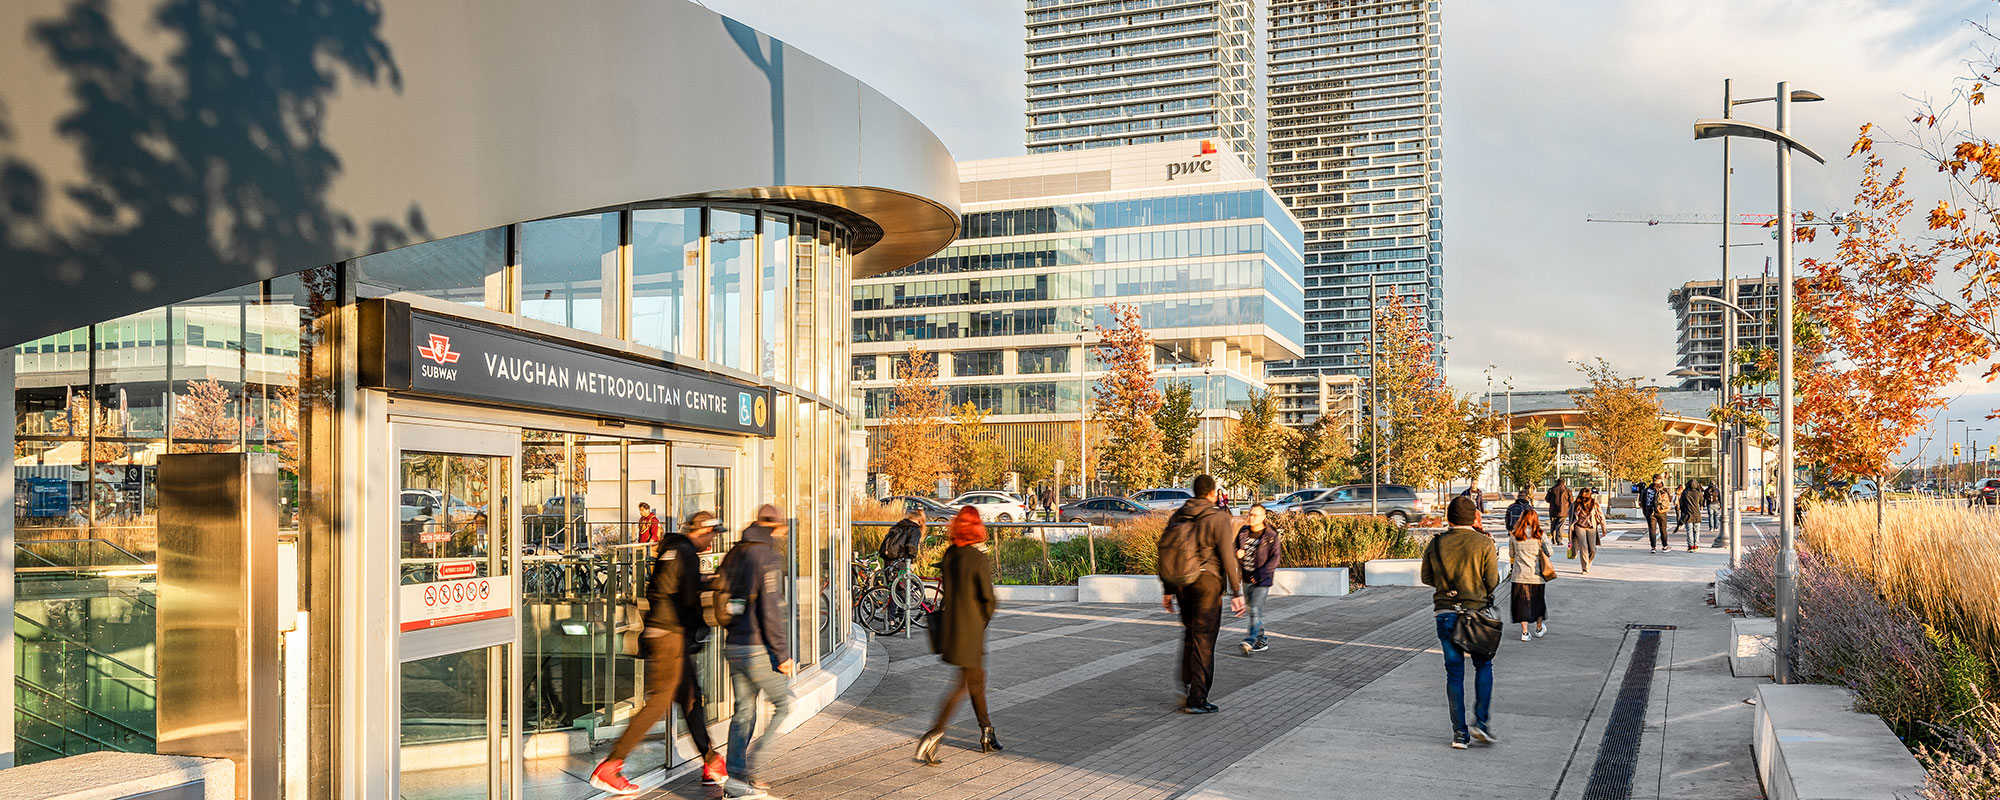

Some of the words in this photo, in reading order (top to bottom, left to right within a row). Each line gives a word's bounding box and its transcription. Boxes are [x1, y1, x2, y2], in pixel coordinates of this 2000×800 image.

[1165, 159, 1212, 181] pwc
[421, 364, 458, 381] SUBWAY
[484, 352, 569, 389] VAUGHAN
[575, 370, 681, 406] METROPOLITAN
[685, 390, 727, 414] CENTRE
